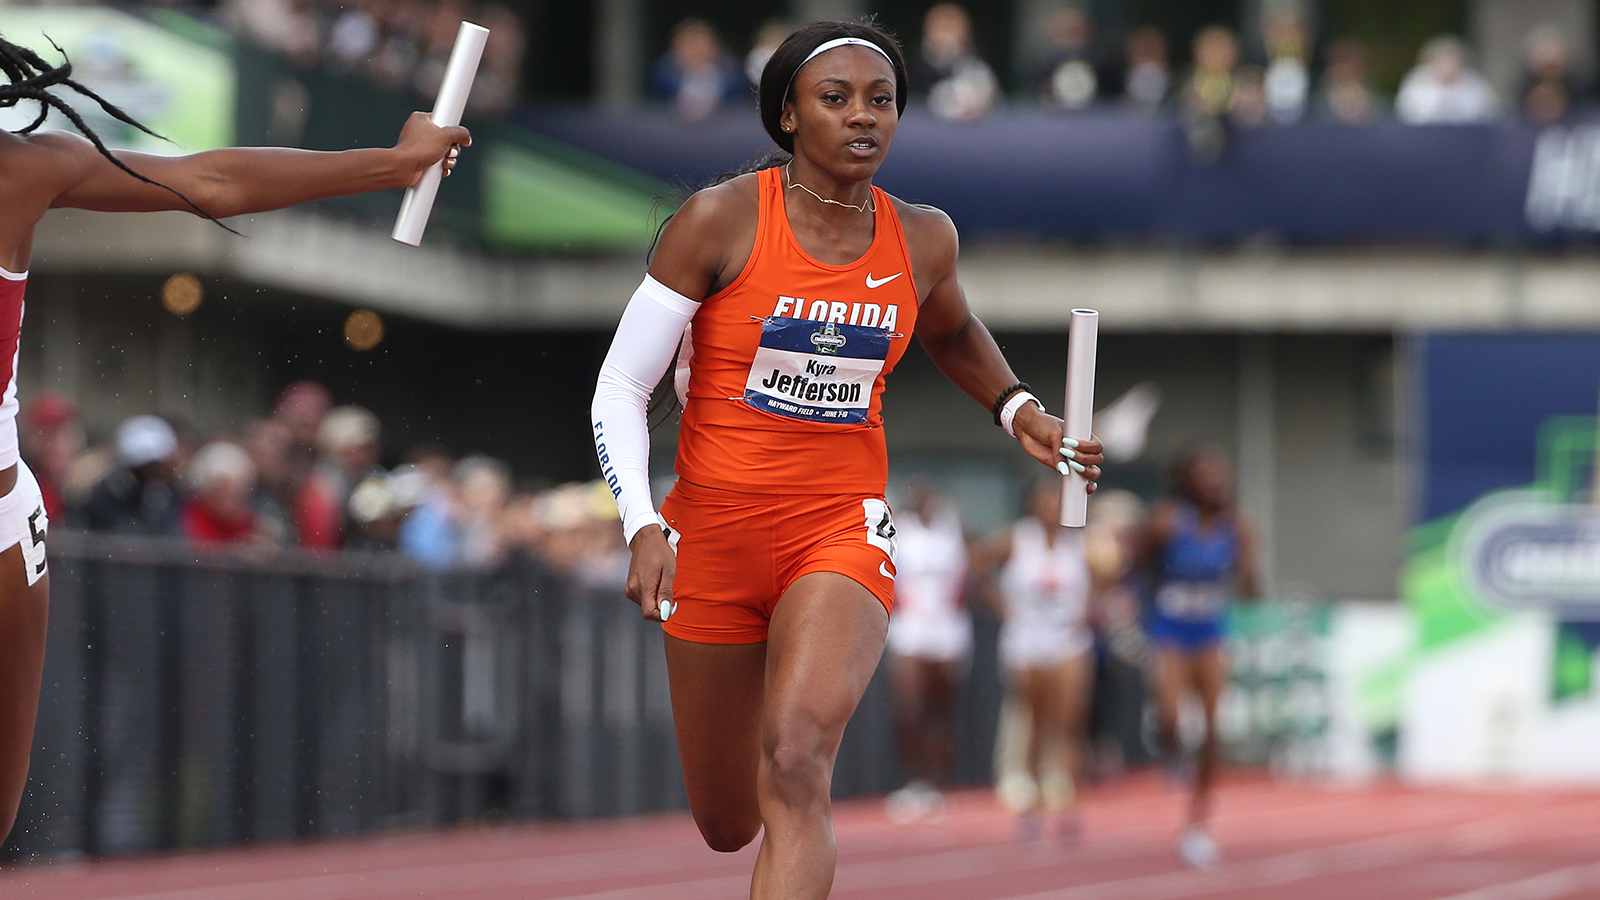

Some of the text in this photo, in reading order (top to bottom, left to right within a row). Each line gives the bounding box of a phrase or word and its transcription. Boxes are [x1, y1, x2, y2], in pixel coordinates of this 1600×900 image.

[772, 295, 899, 332] FLORIDA
[762, 368, 862, 403] Jefferson
[805, 359, 837, 377] Kyra
[767, 399, 798, 413] HAYWARD
[797, 407, 814, 416] FIELD
[821, 410, 838, 418] JUNE
[27, 503, 47, 575] 5
